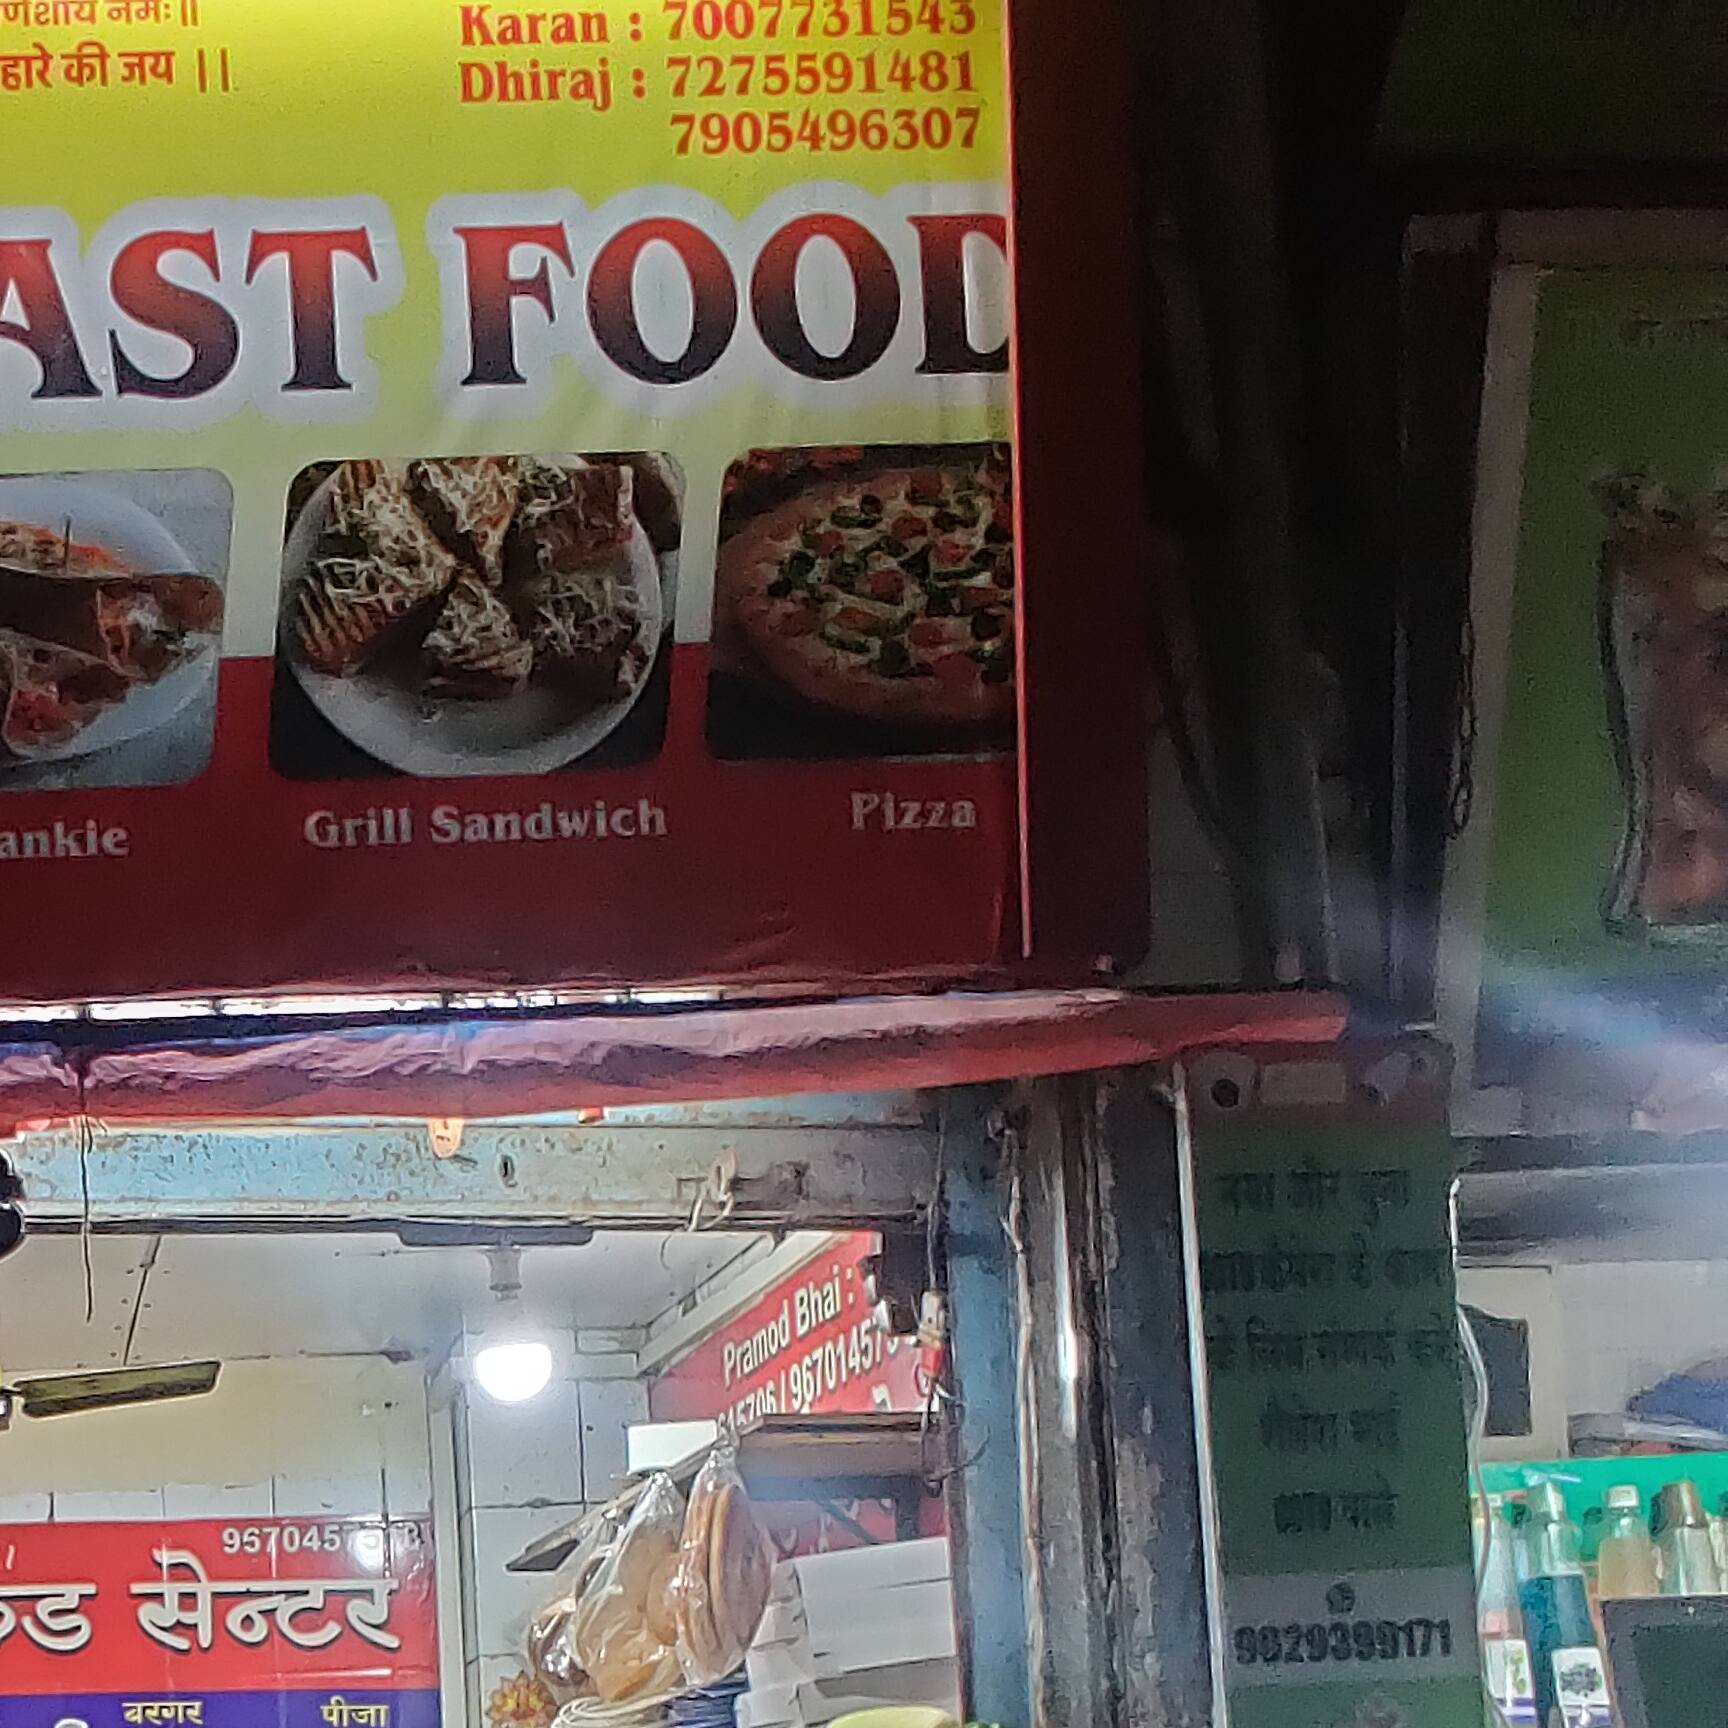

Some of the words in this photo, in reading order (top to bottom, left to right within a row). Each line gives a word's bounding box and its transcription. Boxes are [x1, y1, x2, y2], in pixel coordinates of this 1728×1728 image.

[459, 4, 610, 46] Karan
[664, 0, 975, 41] 7007731543
[61, 41, 110, 87] की
[118, 51, 175, 85] जय
[459, 59, 612, 112] Dhiraj
[666, 51, 977, 97] 7275591481
[670, 107, 981, 156] 7905496307
[453, 212, 1010, 387] FOOD
[303, 806, 413, 850] Grill
[429, 797, 669, 842] Sandwich
[850, 789, 977, 831] Pizza
[724, 1299, 791, 1388] Pramod
[794, 1264, 842, 1338] Bhai
[321, 1695, 389, 1728] पीजा
